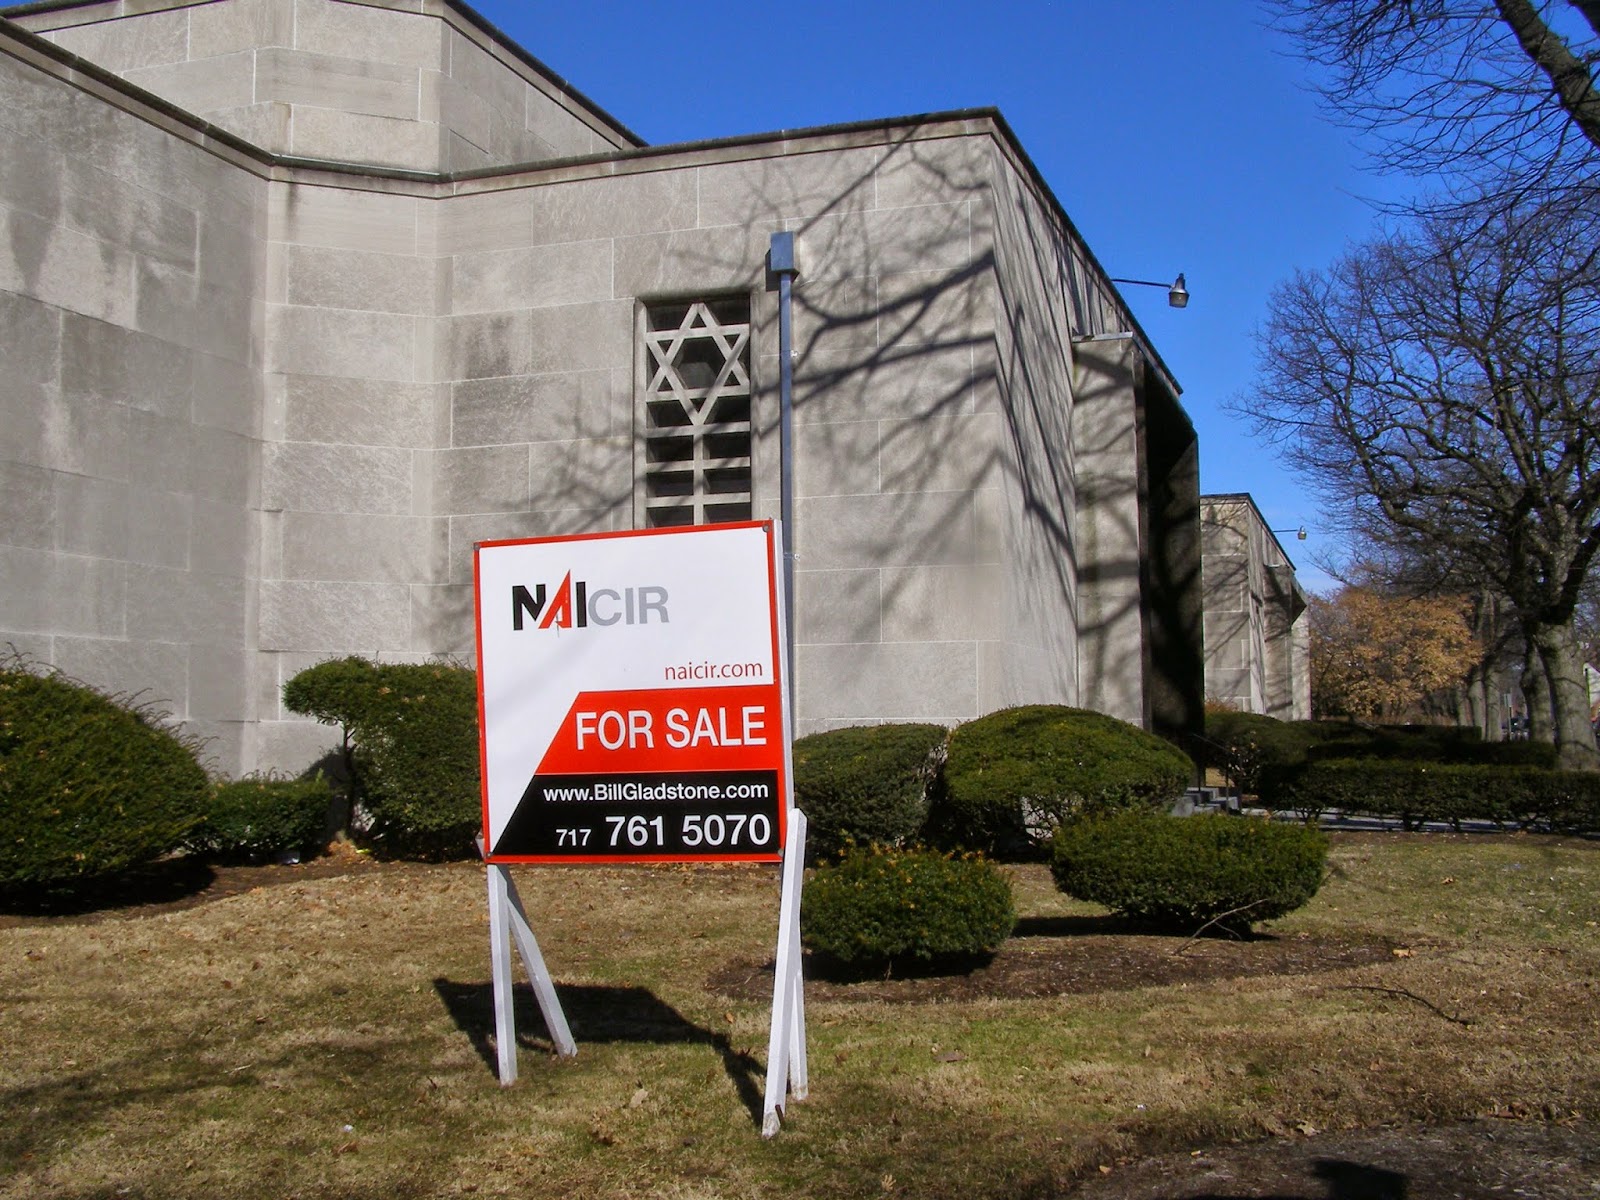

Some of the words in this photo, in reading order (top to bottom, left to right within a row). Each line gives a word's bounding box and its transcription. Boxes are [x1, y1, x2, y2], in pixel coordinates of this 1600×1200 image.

[664, 661, 763, 680] naicir.com
[576, 710, 654, 750] FOR
[665, 706, 767, 747] SALE
[543, 783, 768, 801] www.BillGladstone.com
[555, 829, 592, 846] 717
[605, 815, 665, 846] 761
[681, 813, 771, 846] 5070
